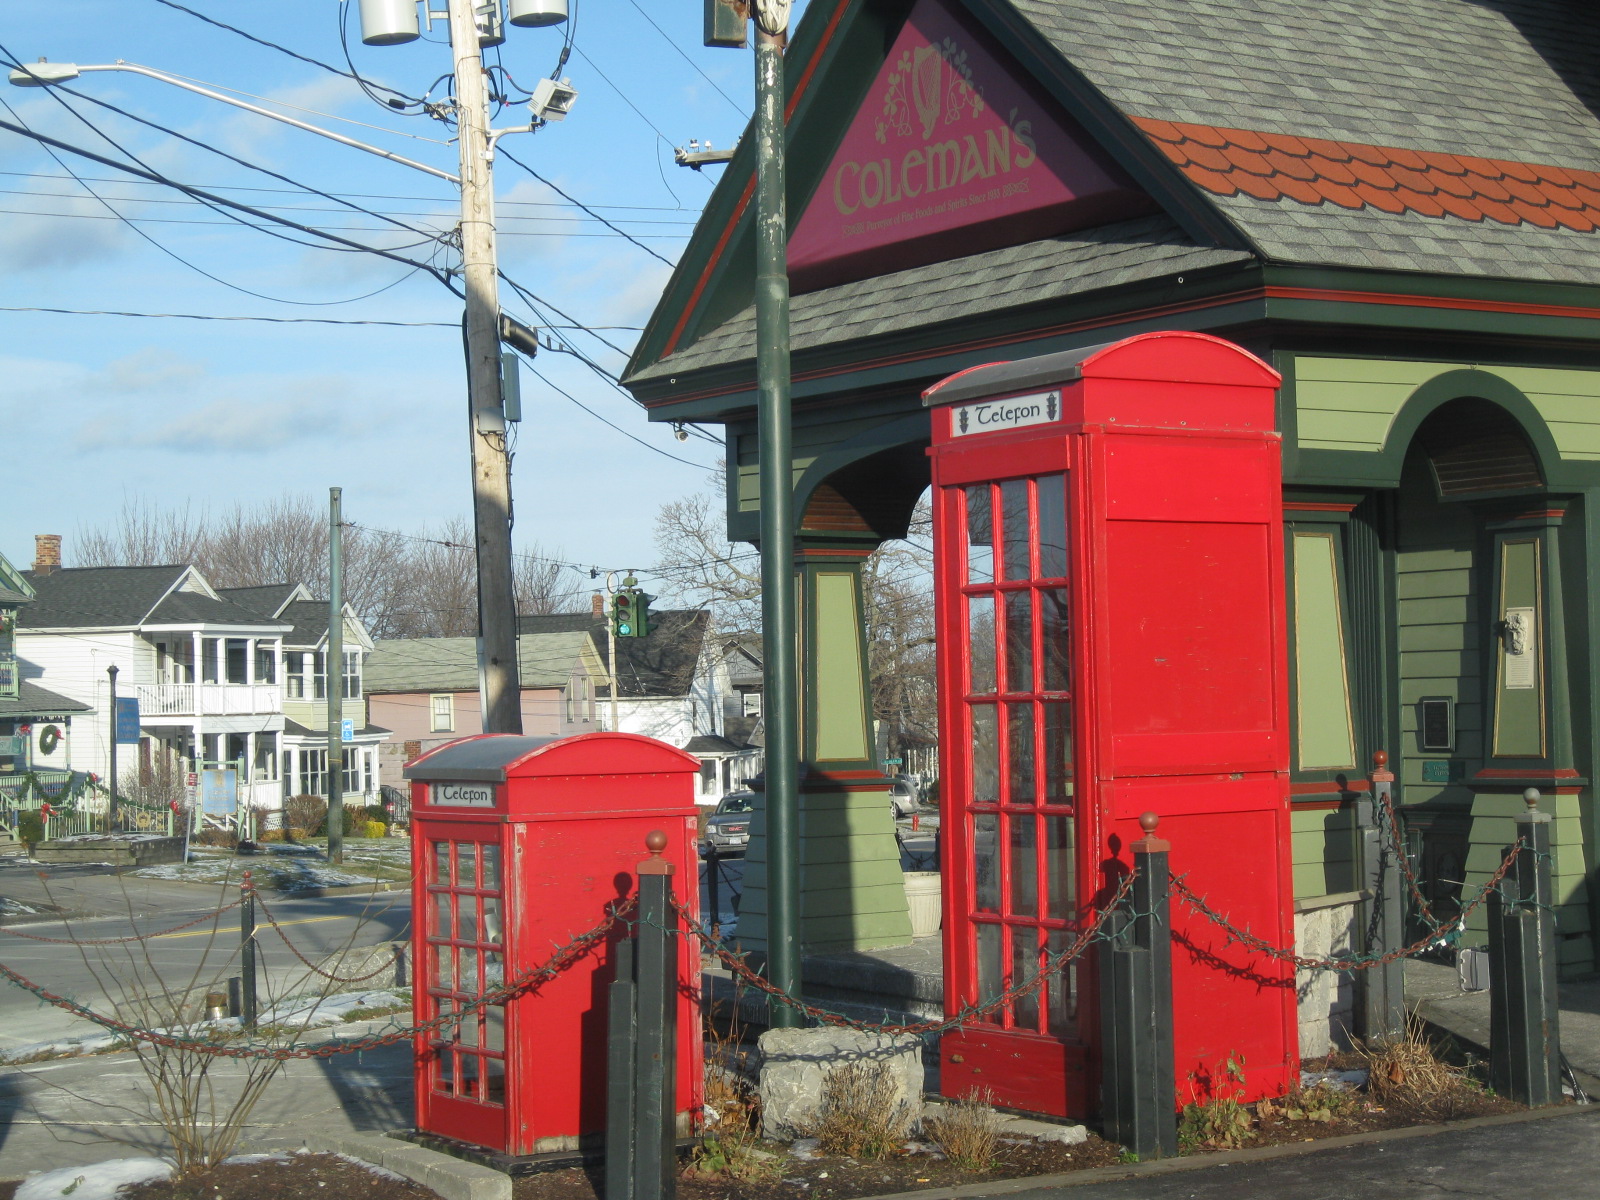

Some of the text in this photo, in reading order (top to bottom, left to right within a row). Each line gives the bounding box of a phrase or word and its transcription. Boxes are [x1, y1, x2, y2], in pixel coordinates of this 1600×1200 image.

[915, 205, 933, 219] Foods
[934, 201, 946, 214] and
[948, 197, 968, 212] Spirits
[969, 193, 986, 206] Since
[975, 405, 1040, 425] Telefon
[441, 784, 488, 804] Telefon
